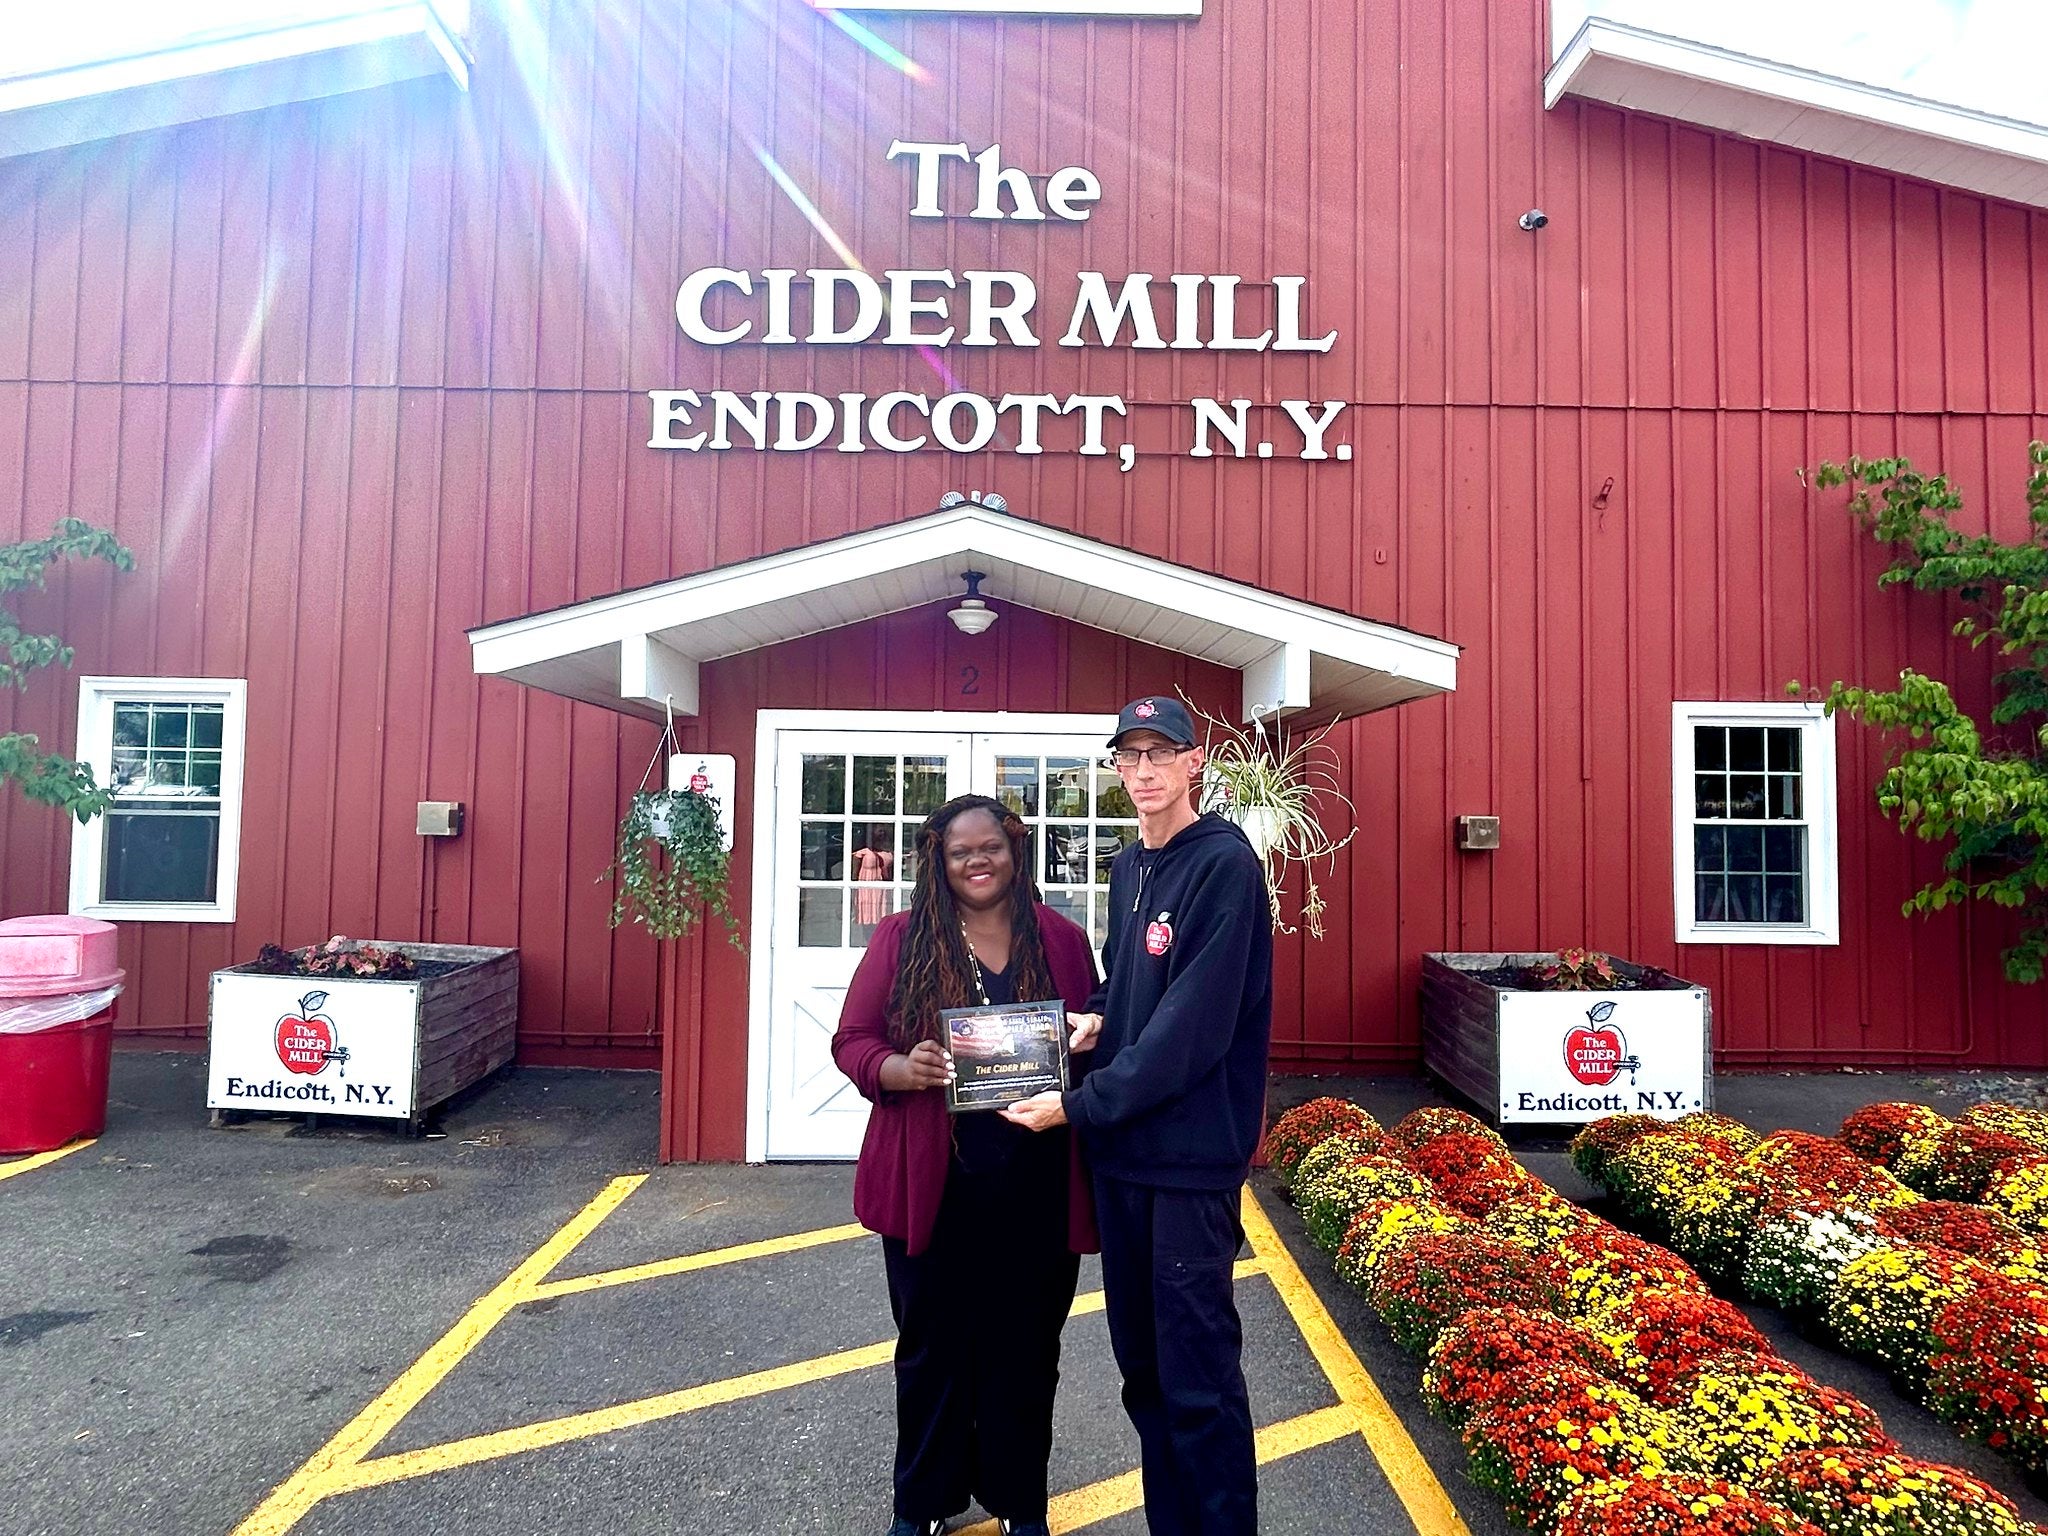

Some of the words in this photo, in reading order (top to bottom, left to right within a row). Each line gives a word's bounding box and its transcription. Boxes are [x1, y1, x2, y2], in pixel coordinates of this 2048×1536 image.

[886, 139, 1102, 221] The
[675, 267, 1041, 348] CIDER
[1058, 271, 1339, 352] MILL
[647, 388, 1136, 471] ENDICOTT,
[1190, 397, 1354, 462] N.Y.
[961, 665, 979, 694] 2
[294, 1024, 317, 1037] The
[284, 1037, 327, 1051] CIDER
[1583, 1036, 1606, 1048] The
[288, 1050, 323, 1063] MILL
[1573, 1049, 1617, 1061] CIDER
[975, 1065, 992, 1075] THE
[993, 1063, 1019, 1074] CIDER
[1019, 1061, 1040, 1072] MILL
[1578, 1062, 1613, 1074] MILL
[226, 1077, 336, 1105] Endicott,
[345, 1084, 394, 1105] N.Y.
[1518, 1092, 1628, 1113] Endicott,
[1637, 1091, 1686, 1110] N.Y.
